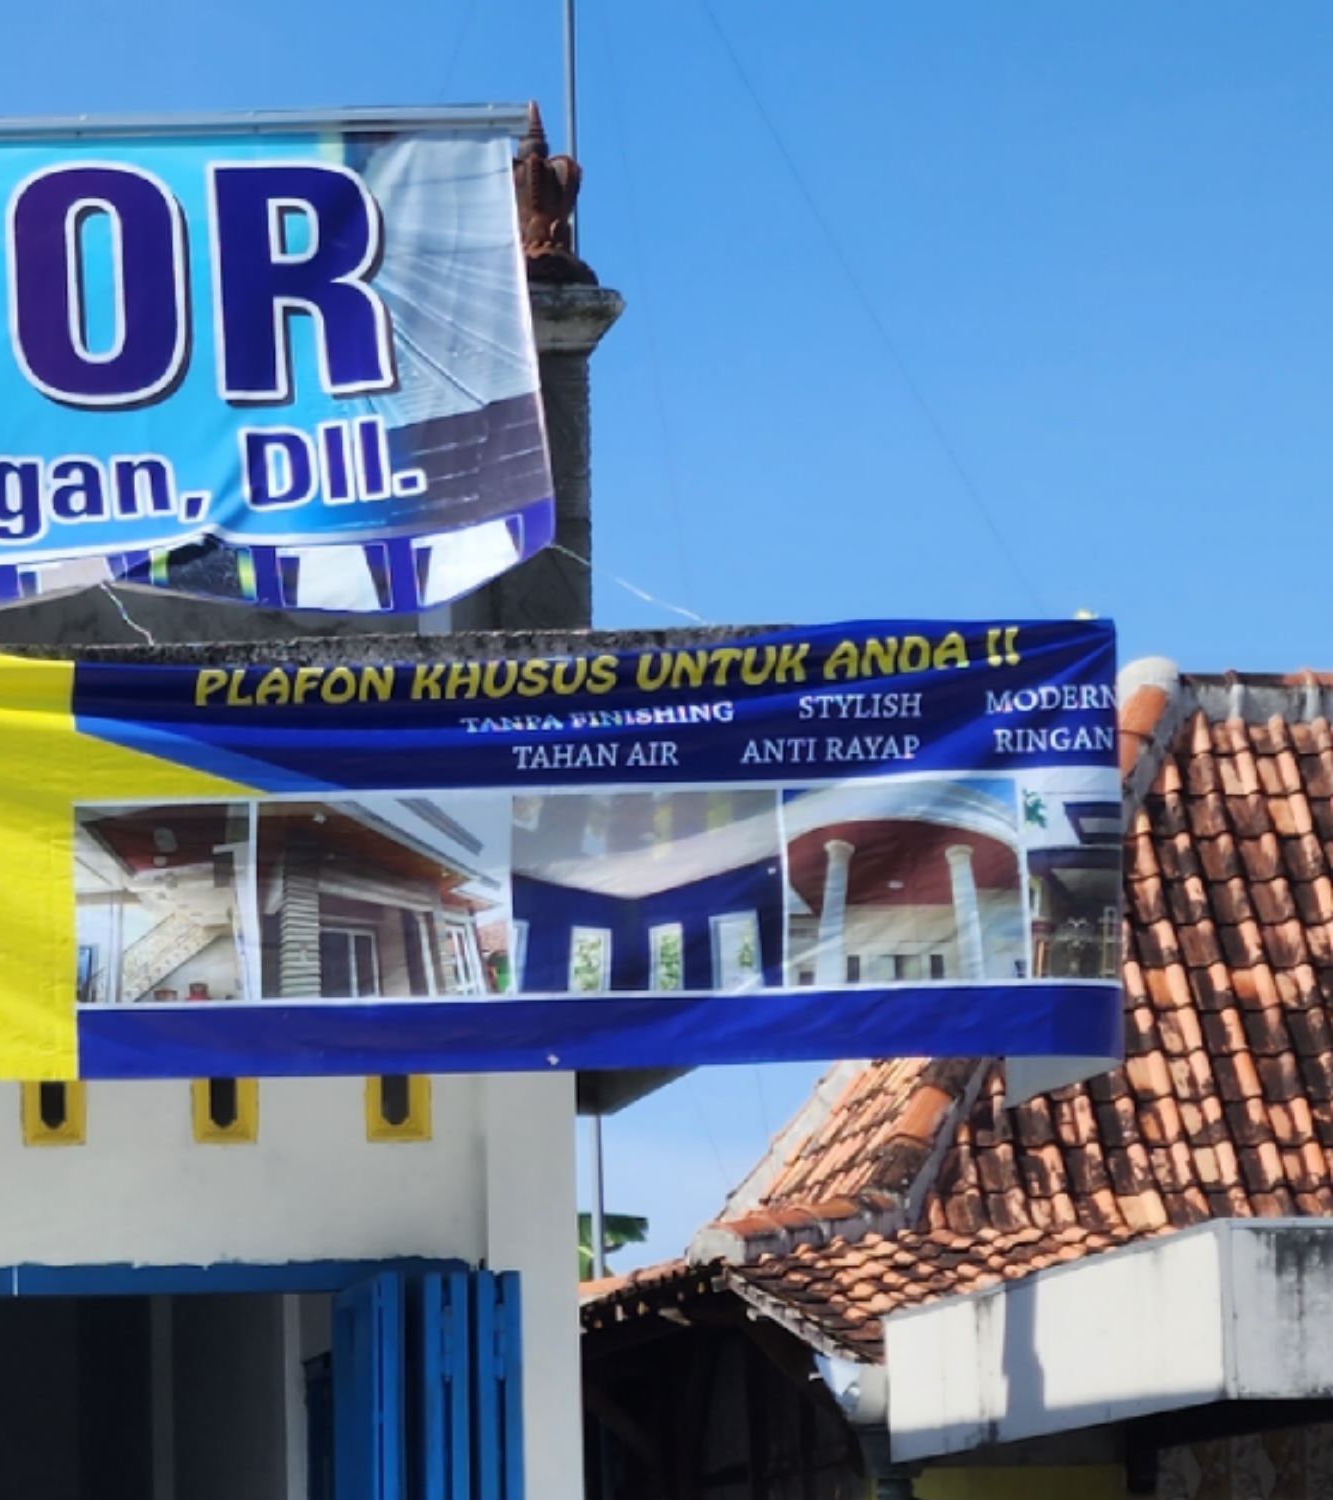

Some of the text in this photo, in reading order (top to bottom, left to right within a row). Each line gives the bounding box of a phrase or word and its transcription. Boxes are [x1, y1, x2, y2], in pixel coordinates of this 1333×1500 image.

[240, 418, 426, 508] Dll.
[193, 663, 395, 708] PLAFON
[411, 654, 620, 700] KHUSUS
[636, 643, 812, 691] UNTUK
[822, 631, 970, 681] ANDA
[798, 692, 923, 721] STYLISH
[985, 683, 1117, 716] MODERN
[460, 701, 735, 734] TANPA FINISHING
[511, 740, 680, 770] TAHAN AIR
[739, 736, 921, 765] ANTI RAYAP
[993, 726, 1115, 754] RINGAN
